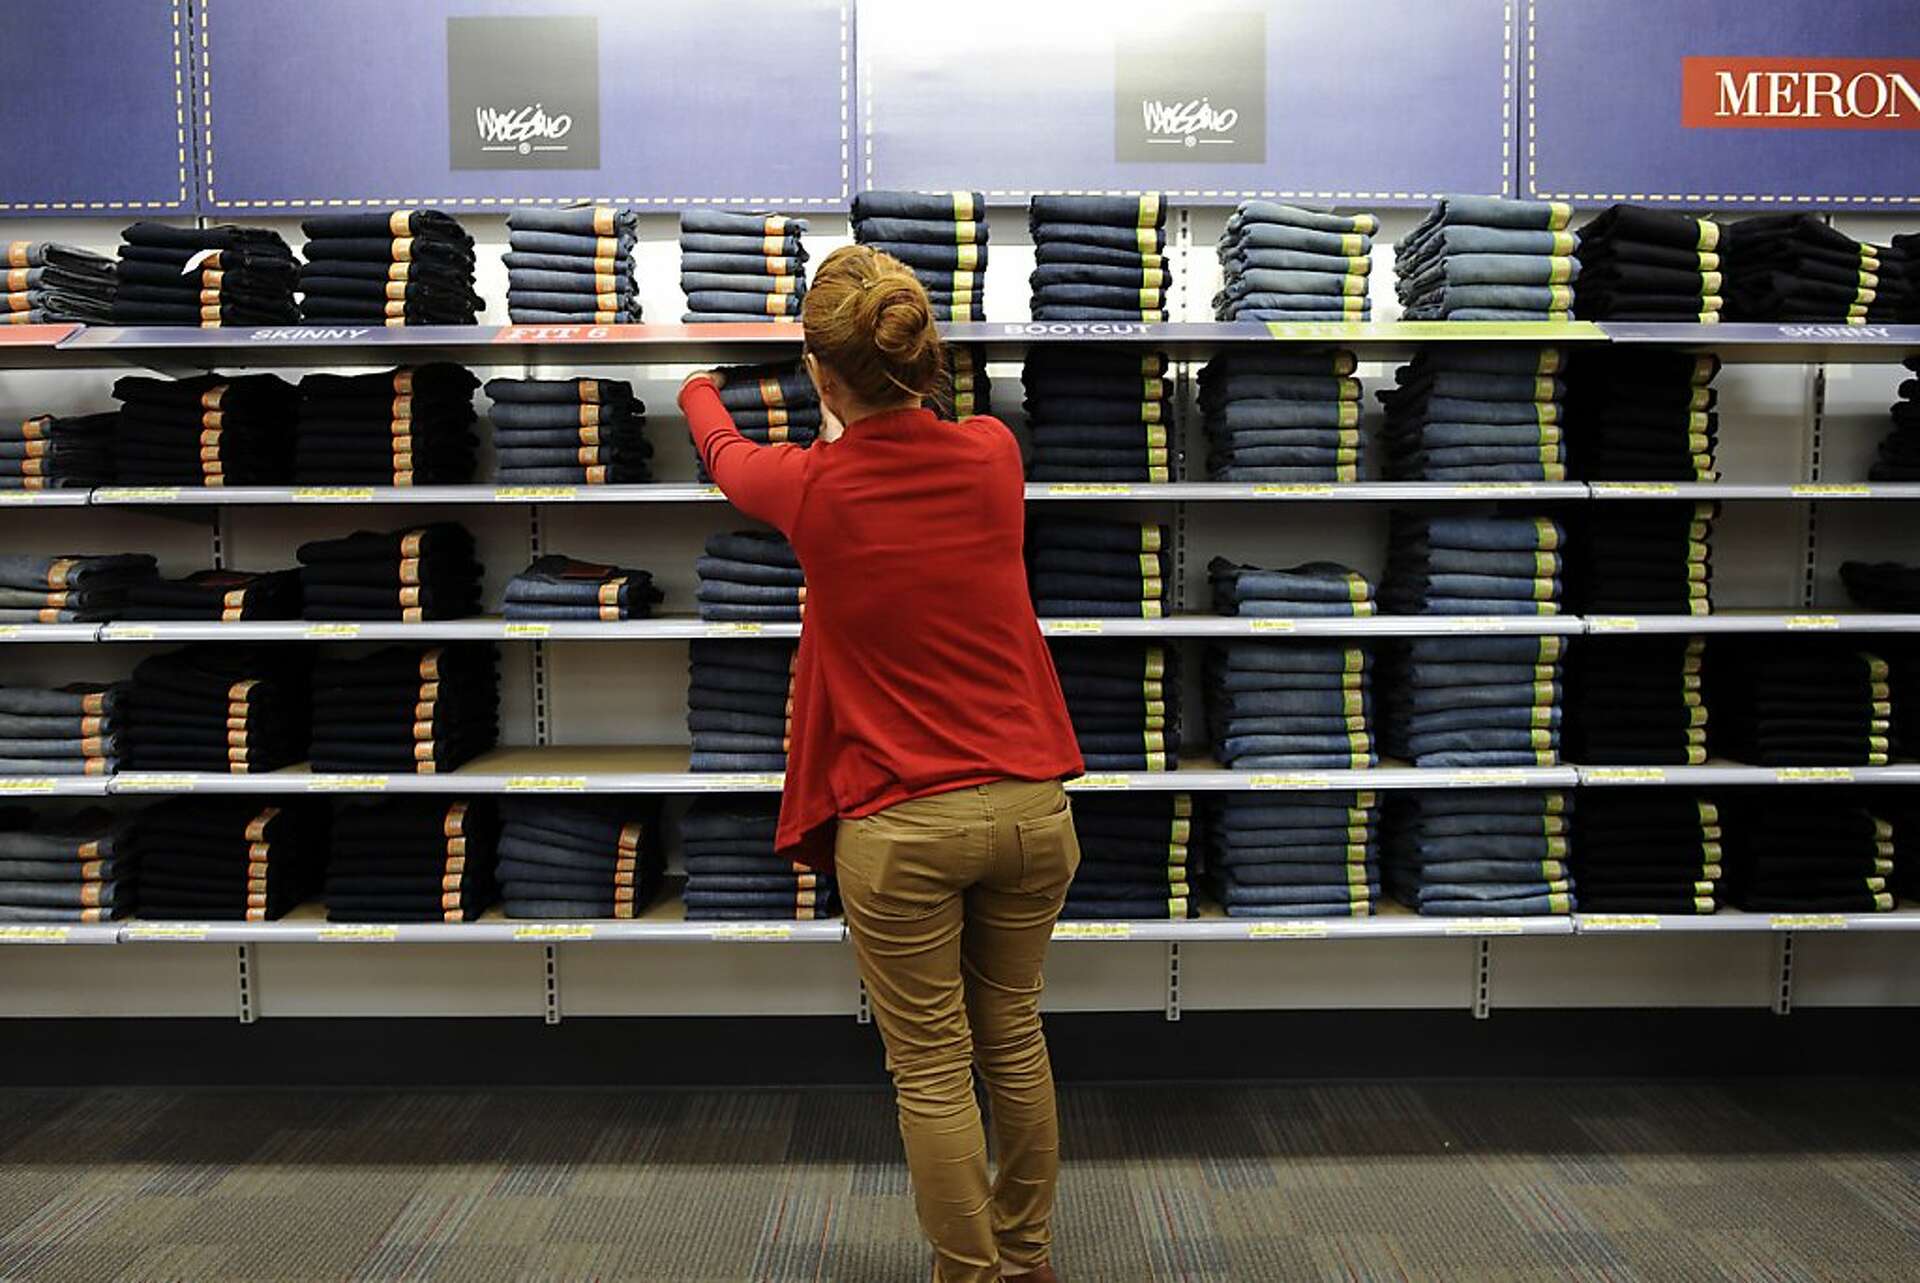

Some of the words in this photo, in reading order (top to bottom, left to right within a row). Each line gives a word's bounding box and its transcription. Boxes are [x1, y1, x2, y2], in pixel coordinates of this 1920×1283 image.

[1714, 70, 1920, 118] MERON
[250, 328, 369, 340] SKINNY
[508, 326, 581, 339] FIT
[1003, 322, 1151, 335] BOOTCUT
[1778, 326, 1890, 338] SKINNY
